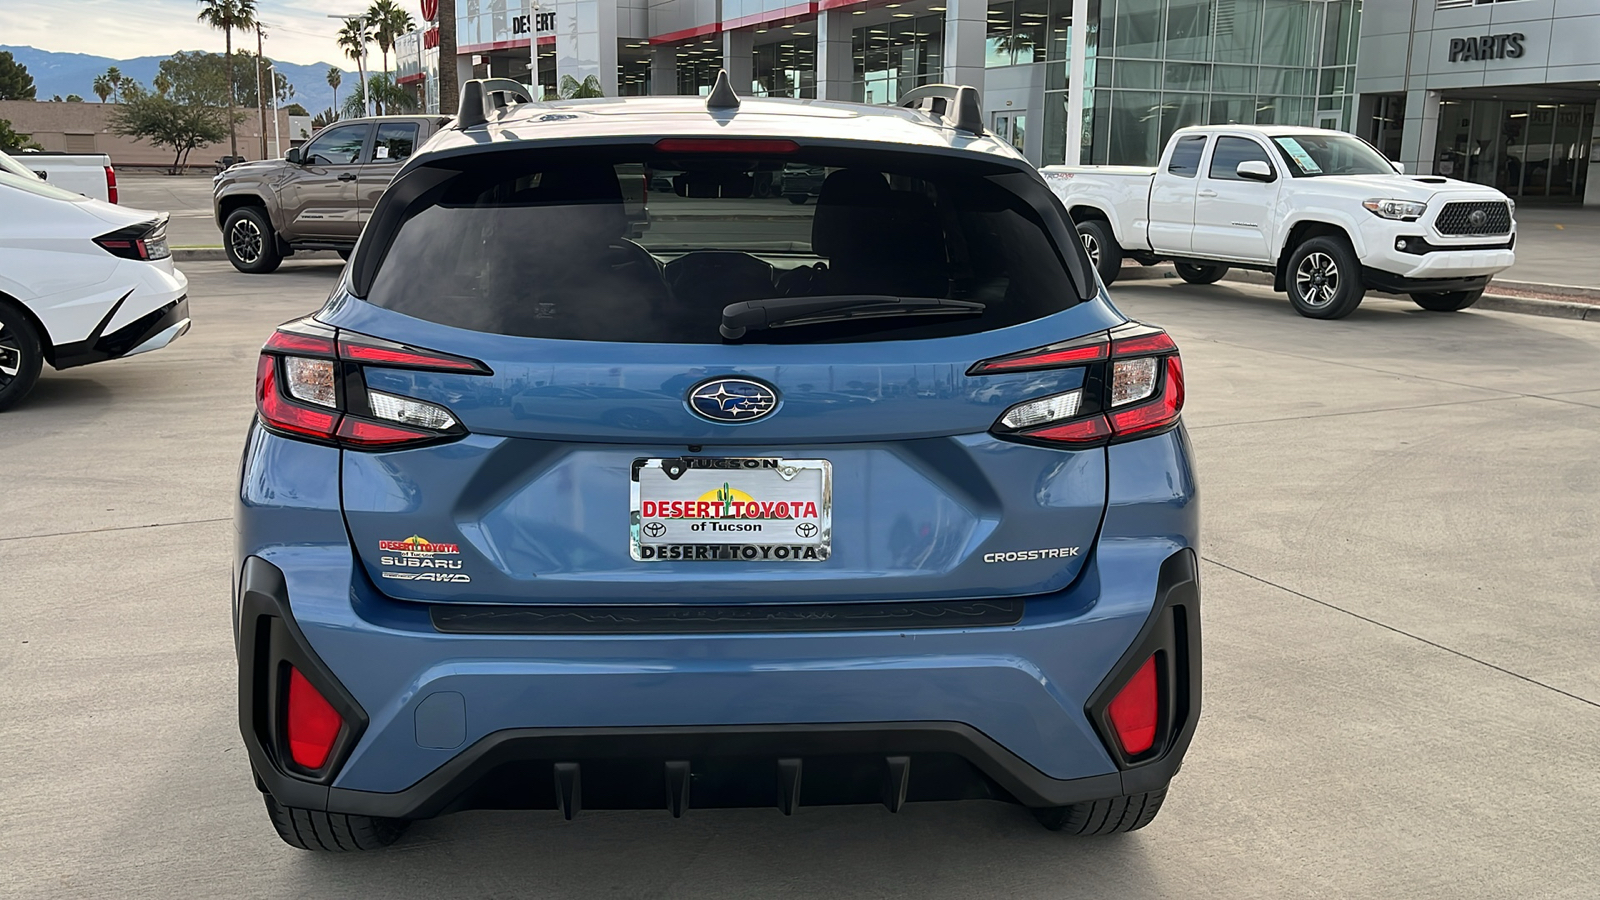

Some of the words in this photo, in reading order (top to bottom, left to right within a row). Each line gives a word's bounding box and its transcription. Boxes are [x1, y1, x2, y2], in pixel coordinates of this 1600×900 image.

[1448, 33, 1525, 62] PARTS
[684, 459, 779, 469] TUCSON
[642, 501, 725, 518] DESERT
[731, 501, 818, 518] TOYOTA
[691, 522, 706, 532] of
[709, 522, 762, 532] Tucson
[379, 541, 415, 551] DESERT
[420, 543, 459, 553] TOYOTA
[641, 546, 720, 559] DESERT
[730, 546, 817, 559] TOYOTA
[983, 546, 1080, 563] CROSSTREK
[380, 556, 462, 569] SUBARU
[414, 572, 471, 583] AWD
